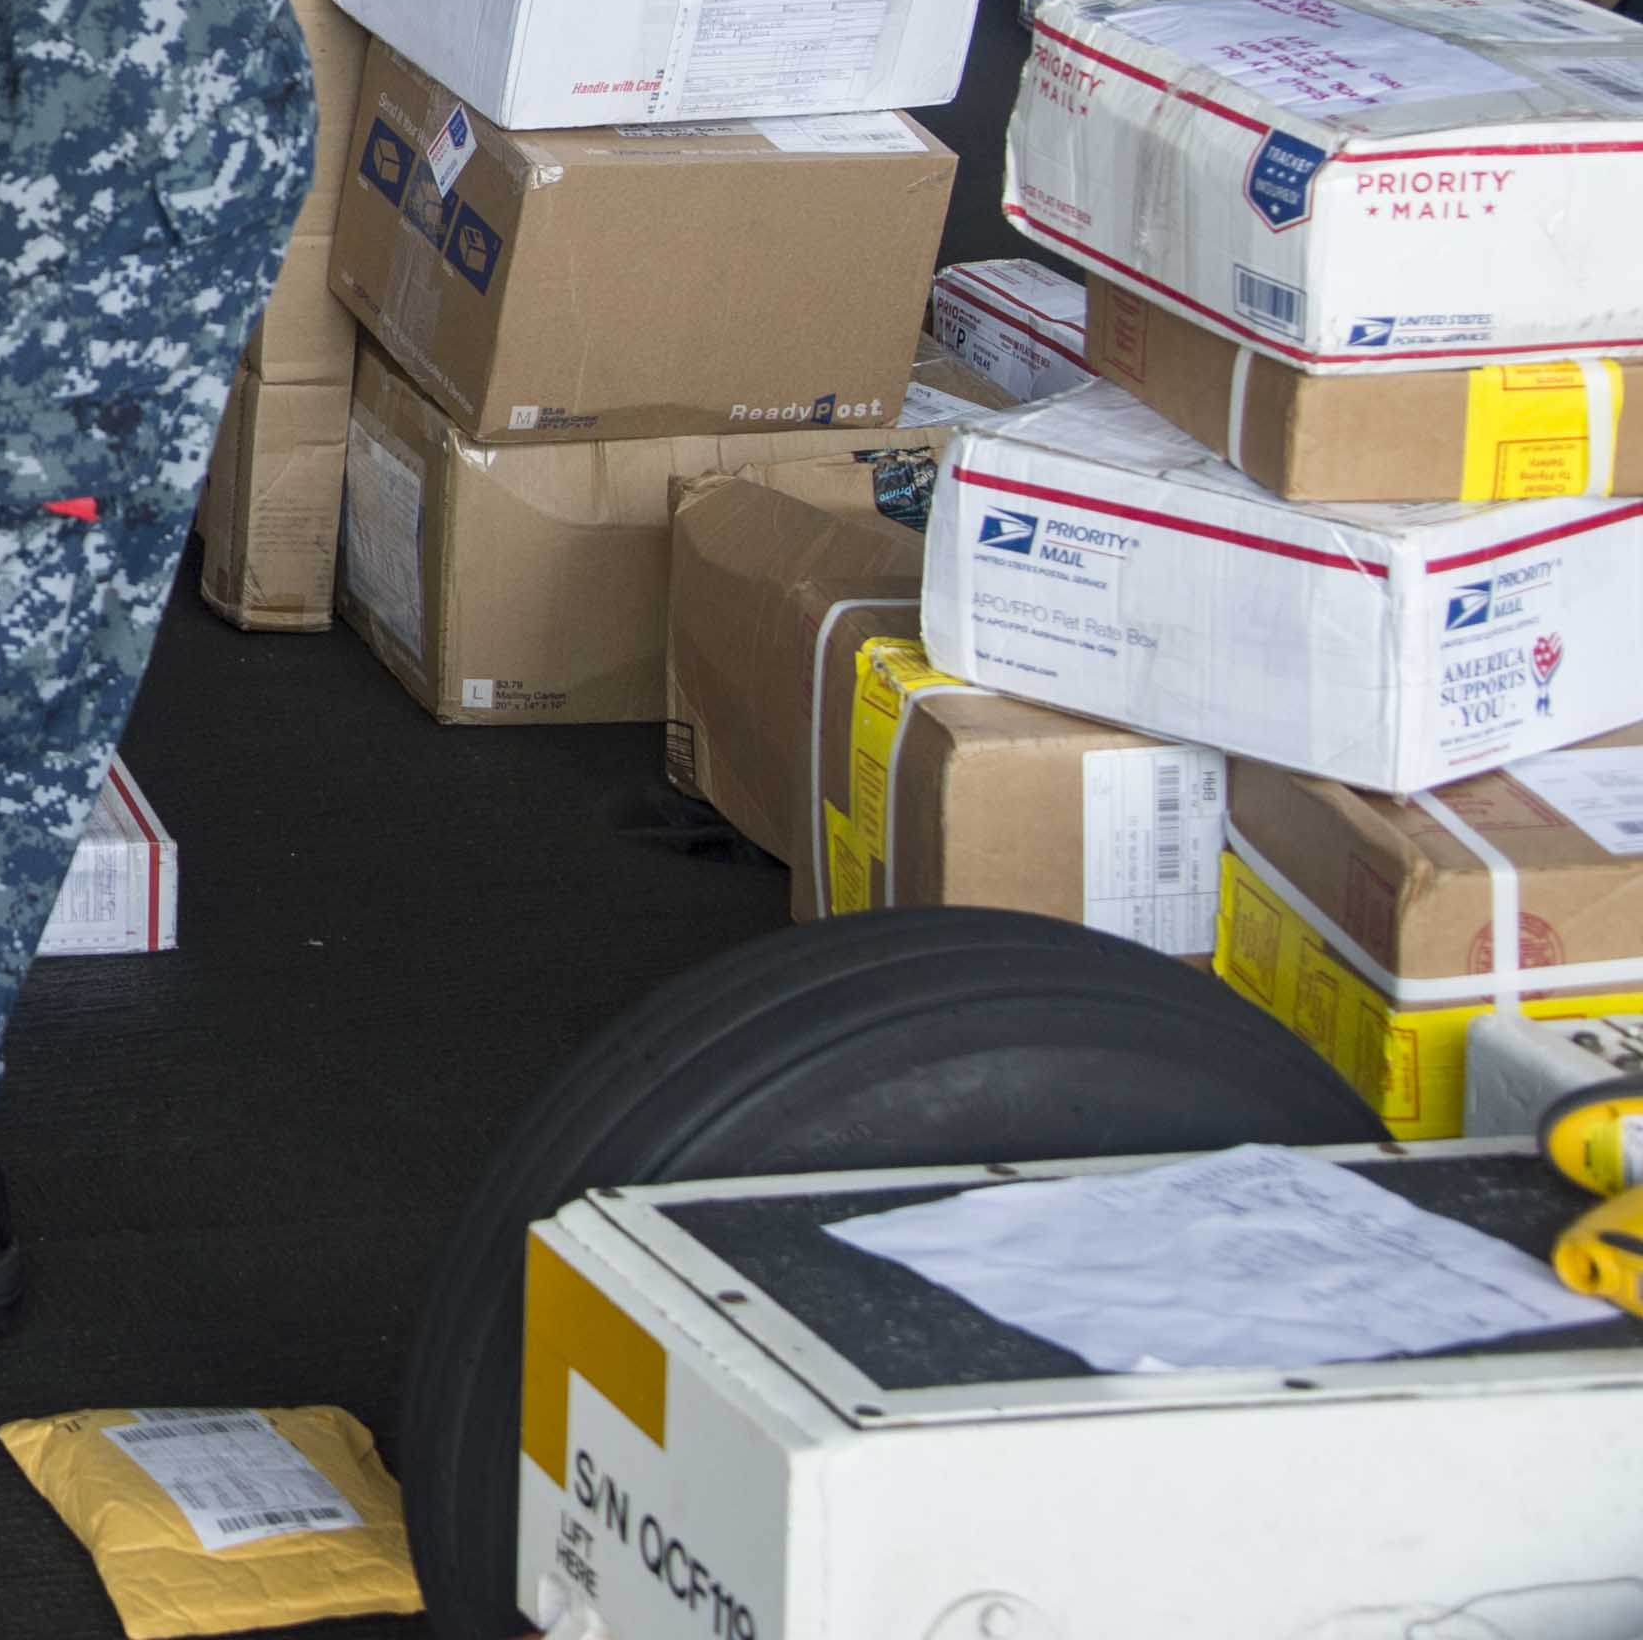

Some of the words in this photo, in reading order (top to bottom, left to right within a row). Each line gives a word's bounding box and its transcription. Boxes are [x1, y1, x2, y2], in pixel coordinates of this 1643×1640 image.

[1034, 44, 1102, 97] PRIORITY
[571, 81, 610, 95] Handle
[611, 79, 635, 93] with
[635, 79, 662, 93] Care
[1041, 79, 1076, 114] MAIL
[1356, 171, 1510, 194] PRIORITY
[1392, 202, 1469, 220] MAIL
[956, 328, 967, 350] P
[515, 411, 531, 426] M
[728, 396, 884, 423] ReadyPost
[1045, 520, 1131, 552] PRIORITY
[1039, 544, 1085, 570] MAIL
[1441, 648, 1527, 685] AMERICA
[1440, 670, 1527, 708] SUPPORTS
[1460, 697, 1505, 727] YOU
[574, 1448, 629, 1545] S/N
